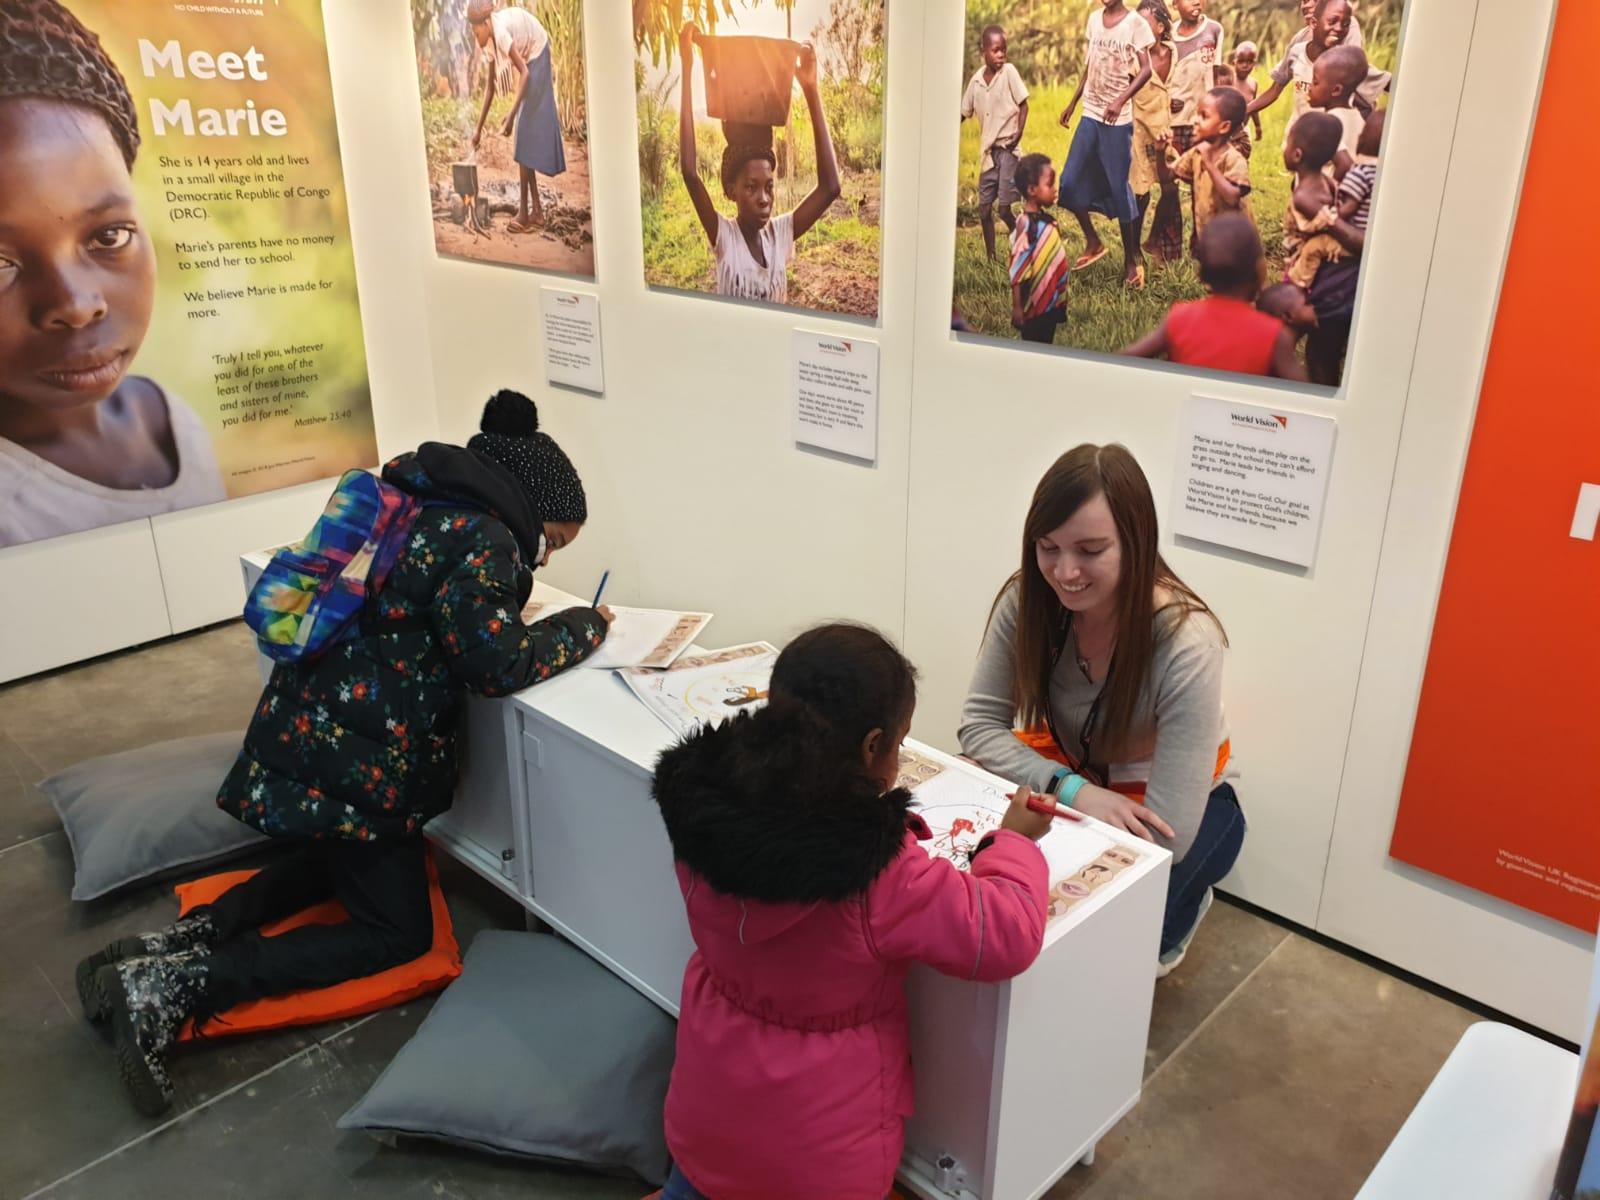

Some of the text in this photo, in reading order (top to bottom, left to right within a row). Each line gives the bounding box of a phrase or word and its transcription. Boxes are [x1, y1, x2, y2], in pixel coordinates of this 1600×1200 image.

[187, 5, 205, 13] CHILD
[206, 6, 235, 15] WITHOUT
[242, 9, 264, 17] FUTURE
[138, 39, 268, 81] Meet
[148, 98, 288, 136] Marie
[160, 155, 309, 169] She is 14 years old and lives
[163, 172, 284, 185] in a small village in the
[166, 187, 330, 202] Democratic Republic of Congo
[170, 208, 210, 222] (DRC).
[175, 235, 335, 253] Marie's parents have no money
[178, 252, 295, 270] to send her to school.
[184, 279, 332, 302] We believe Marie is made for
[188, 309, 220, 319] more.
[241, 352, 243, 361] I
[247, 350, 260, 360] tell
[264, 350, 282, 360] you,
[284, 344, 323, 354] whatever
[215, 358, 313, 383] you did for one of the
[217, 373, 318, 396] least of these brothers
[220, 390, 308, 411] and sisters of mine,
[222, 417, 238, 429] you
[242, 411, 256, 422] did
[259, 409, 271, 421] for
[294, 409, 351, 427] Matthew 25:40
[1231, 413, 1278, 428] World Vision
[1194, 435, 1210, 444] Marie
[1236, 443, 1256, 452] friends
[1258, 448, 1274, 456] often
[1276, 451, 1288, 460] play
[1191, 462, 1210, 472] singing
[1209, 447, 1230, 456] outside
[1244, 454, 1264, 464] school
[1265, 458, 1278, 468] they
[1280, 461, 1295, 470] can't
[1296, 465, 1315, 474] afford
[1220, 458, 1236, 467] Marie
[1238, 462, 1253, 470] leads
[1267, 468, 1287, 478] friends
[1188, 478, 1213, 489] Children
[1230, 488, 1240, 496] gift
[1242, 490, 1256, 498] from
[1274, 497, 1287, 505] Our
[1288, 501, 1302, 509] goal
[1185, 504, 1205, 514] believe
[1206, 509, 1219, 517] they
[1232, 514, 1248, 523] made
[1198, 498, 1214, 506] Marie
[1228, 504, 1238, 512] her
[1262, 512, 1286, 523] because
[1240, 499, 1262, 509] protect
[1264, 504, 1282, 513] God's
[1498, 848, 1523, 862] World
